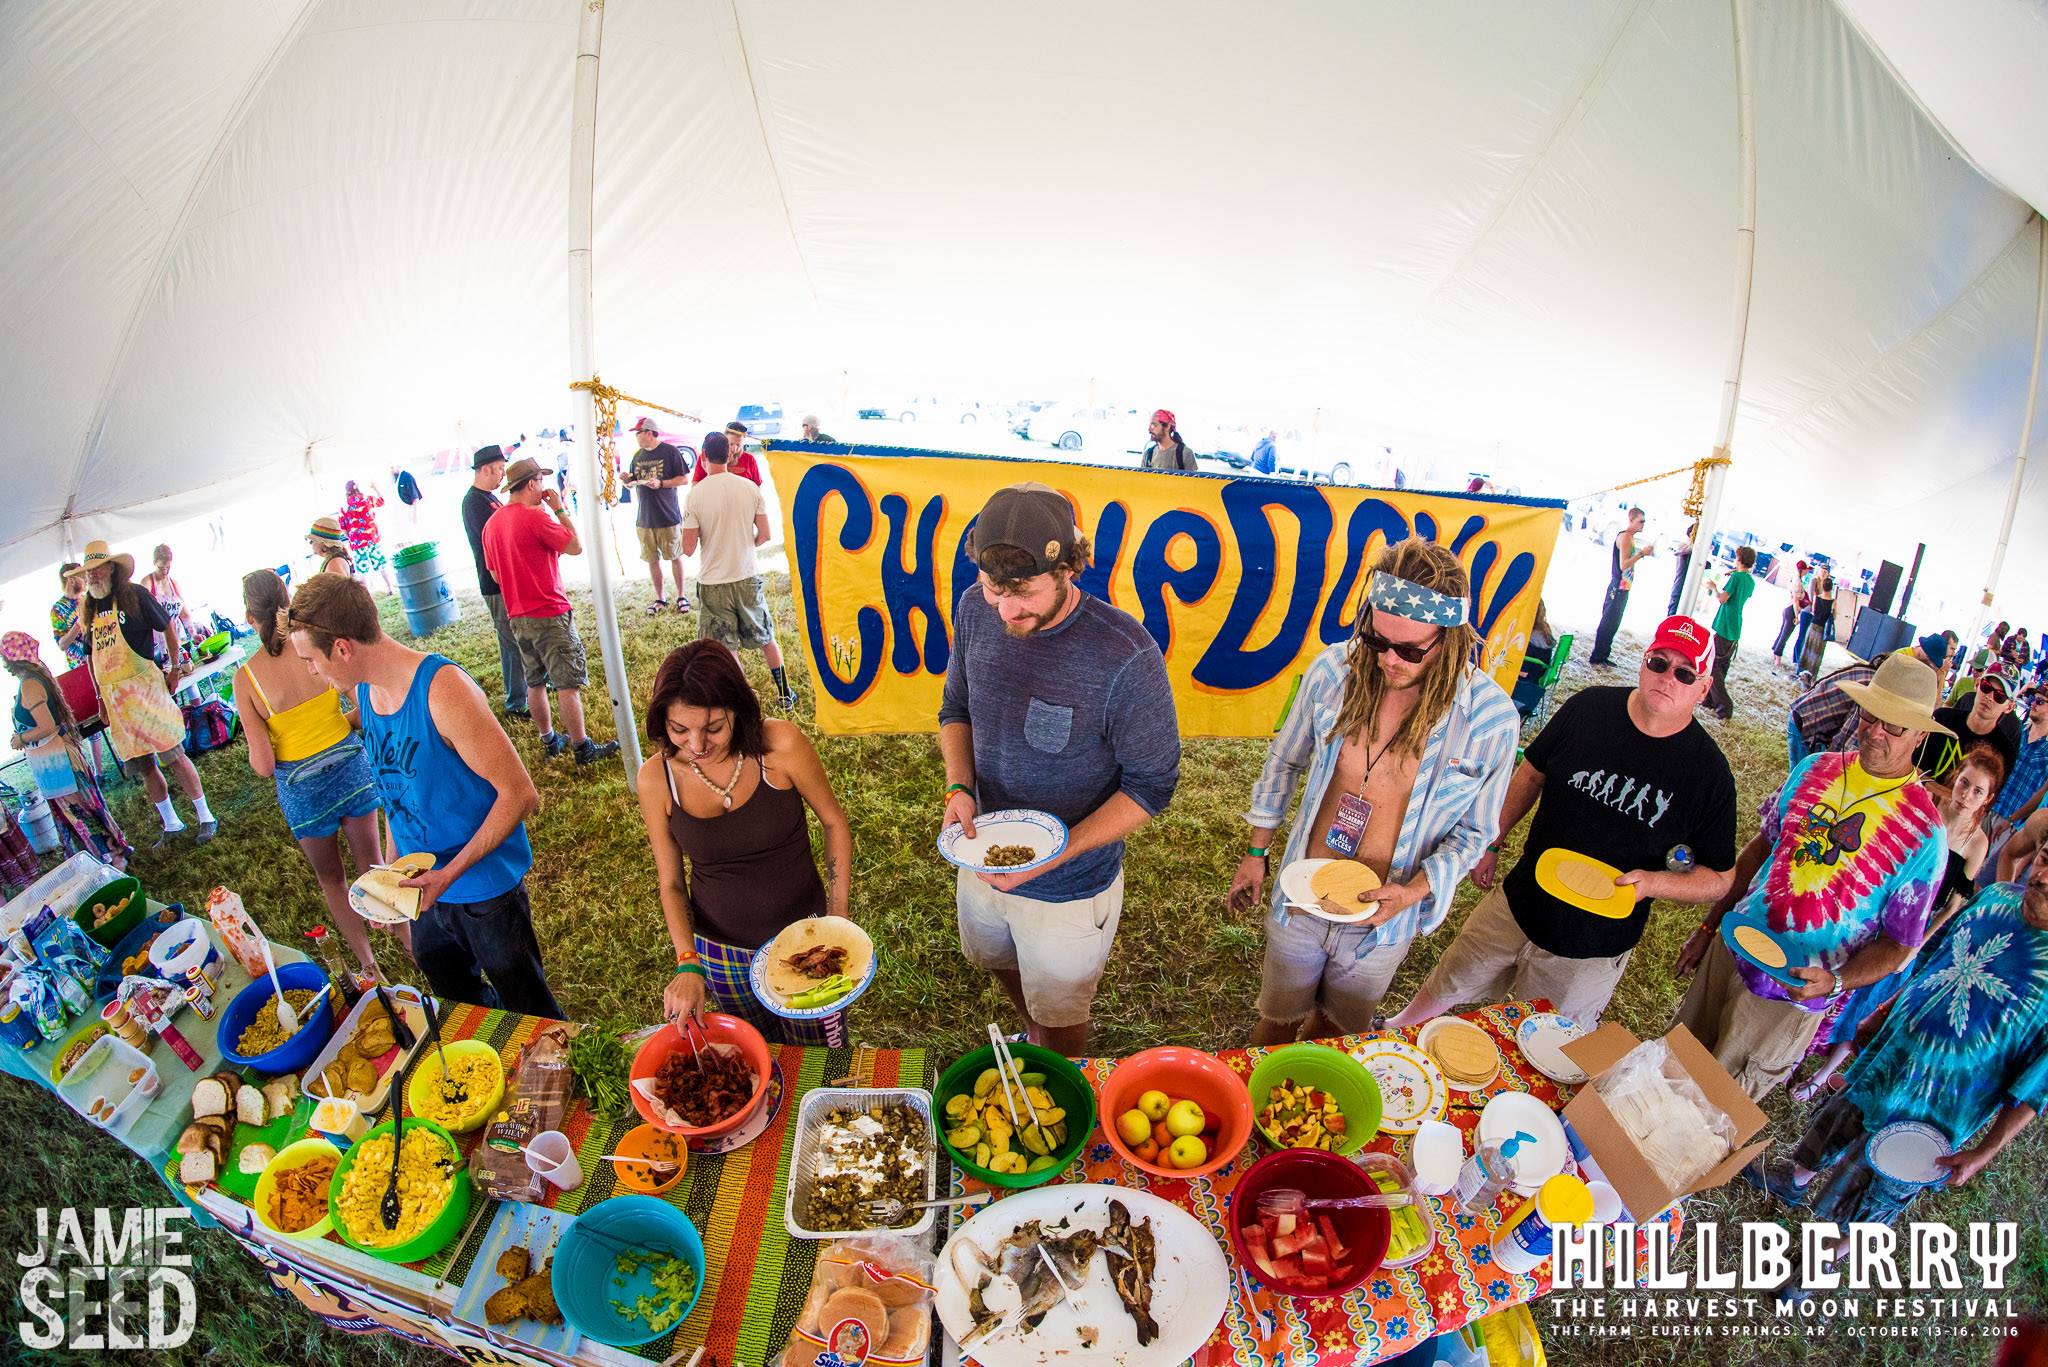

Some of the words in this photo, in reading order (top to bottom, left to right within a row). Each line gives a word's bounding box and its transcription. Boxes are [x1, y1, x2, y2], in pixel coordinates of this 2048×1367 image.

[96, 634, 117, 651] DOWN
[1330, 837, 1352, 853] ACCESS
[1337, 833, 1349, 844] ALL
[497, 1128, 525, 1139] WHEAT
